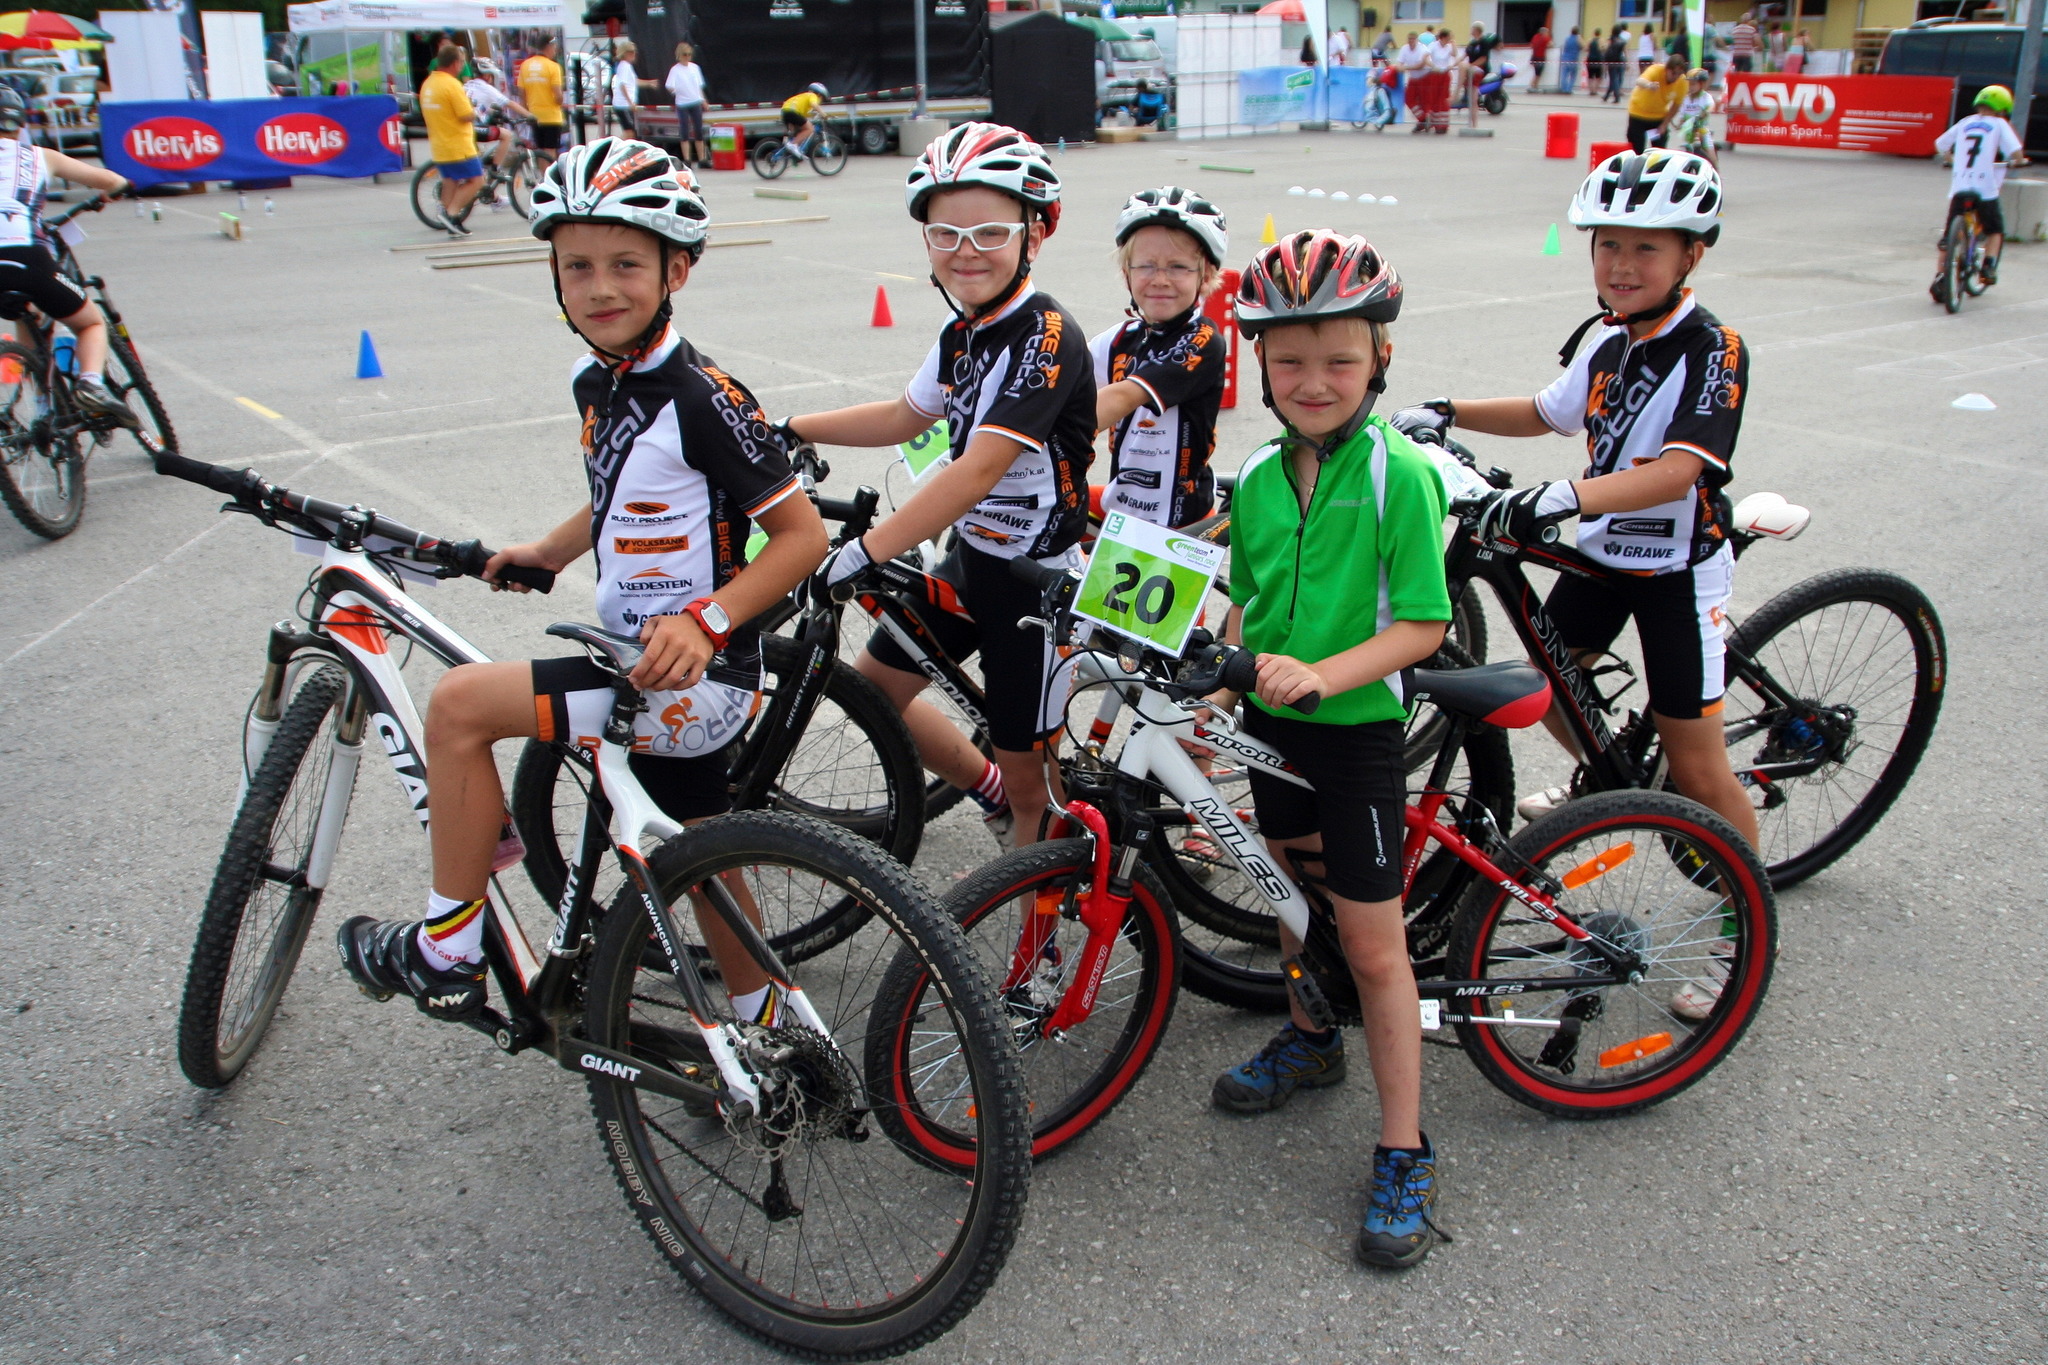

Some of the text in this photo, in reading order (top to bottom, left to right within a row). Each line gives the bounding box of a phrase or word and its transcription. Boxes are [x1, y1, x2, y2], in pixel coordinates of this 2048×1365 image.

[131, 128, 220, 160] Hervis
[263, 124, 346, 155] Hervis
[1744, 124, 1788, 137] machen
[1965, 134, 1983, 168] 7
[1040, 310, 1062, 355] BIKE
[1695, 350, 1726, 415] total
[711, 390, 765, 464] total
[611, 513, 688, 523] RUDY PROJECT
[1127, 497, 1160, 512] GRAWE
[983, 510, 1033, 531] GRAWE
[1620, 523, 1667, 531] SCHWALBE
[632, 537, 685, 547] VOLKSBANK
[1476, 548, 1494, 561] LISA
[1622, 546, 1676, 559] GRAWE
[617, 578, 693, 592] VREDESTEIN
[1102, 562, 1176, 625] 20
[785, 644, 820, 729] RITCHEY CARBON
[1191, 797, 1291, 902] MILES
[553, 865, 579, 948] GIANT
[1500, 879, 1559, 921] MILES
[422, 934, 469, 963] BELGIUM
[641, 893, 681, 976] ADVANCED SL
[428, 991, 471, 1009] NW
[1455, 984, 1525, 997] MILES
[580, 1053, 641, 1082] GIANT
[606, 1120, 685, 1258] NOBBY NIC
